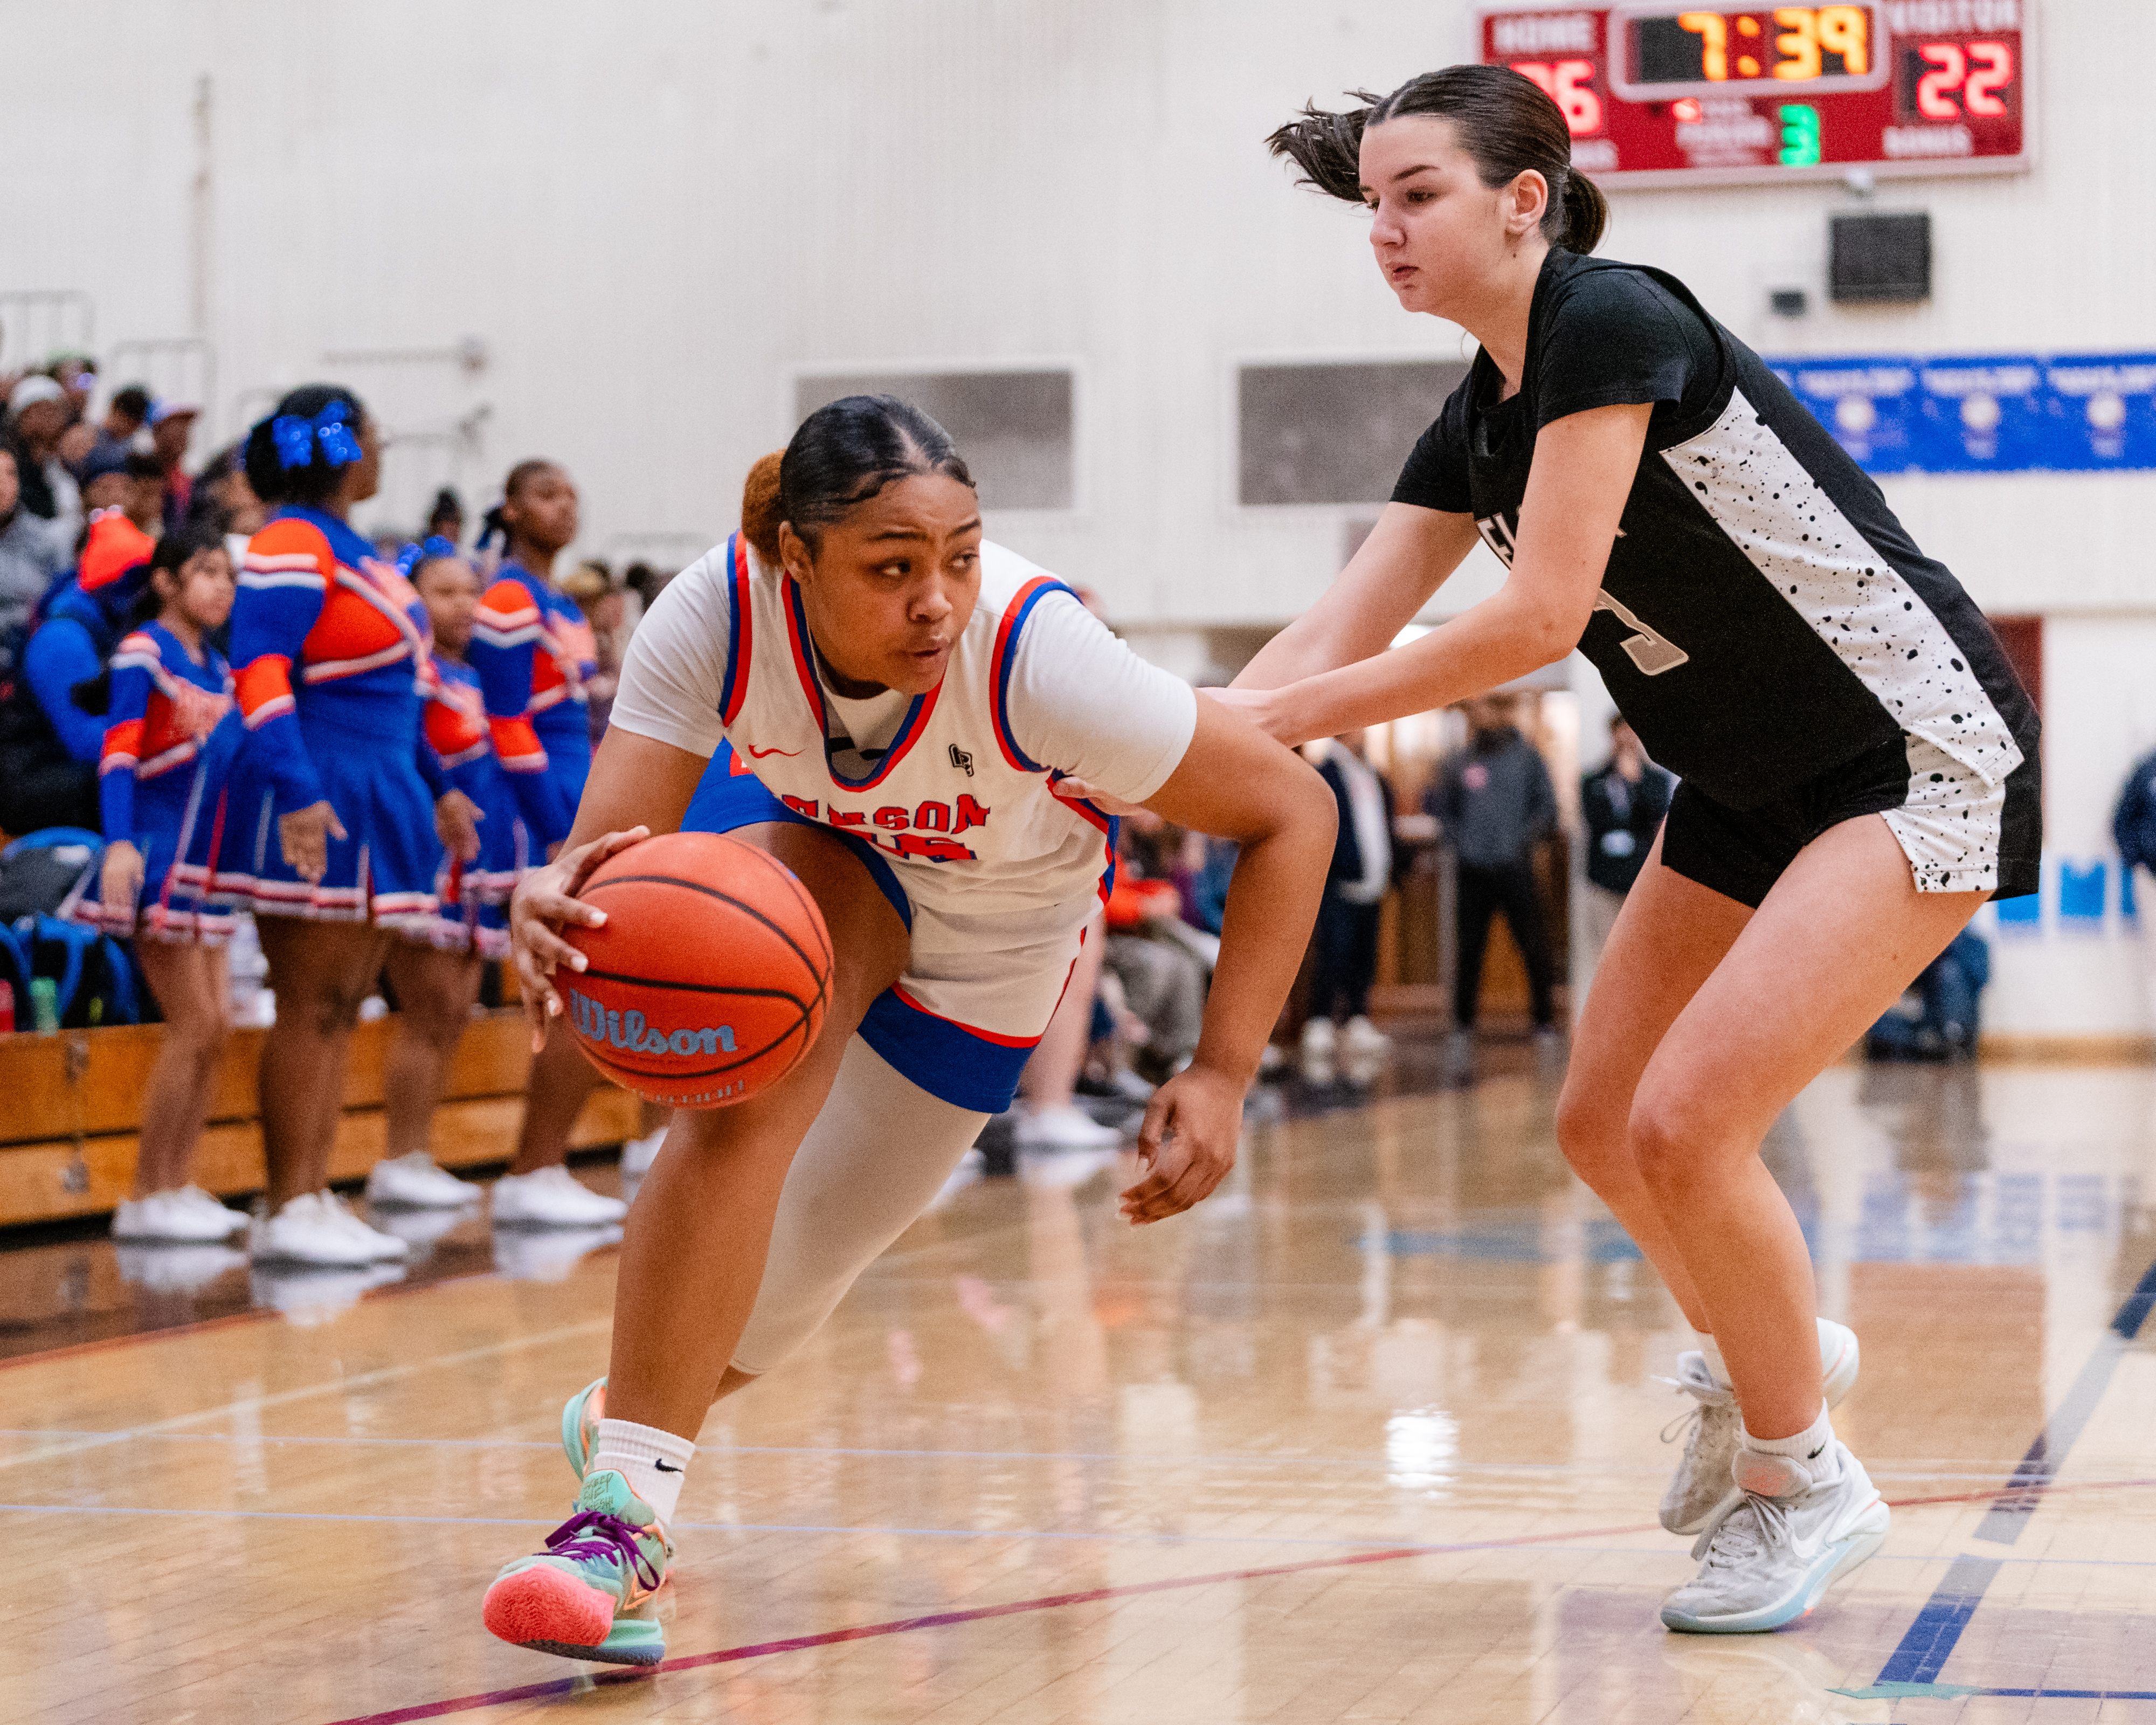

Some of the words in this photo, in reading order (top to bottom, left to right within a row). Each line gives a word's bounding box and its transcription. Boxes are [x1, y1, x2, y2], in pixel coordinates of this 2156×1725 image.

[1678, 6, 1867, 81] 7:39
[1917, 41, 2014, 119] 22
[1780, 105, 1820, 168] 3
[569, 988, 738, 1055] Wilson
